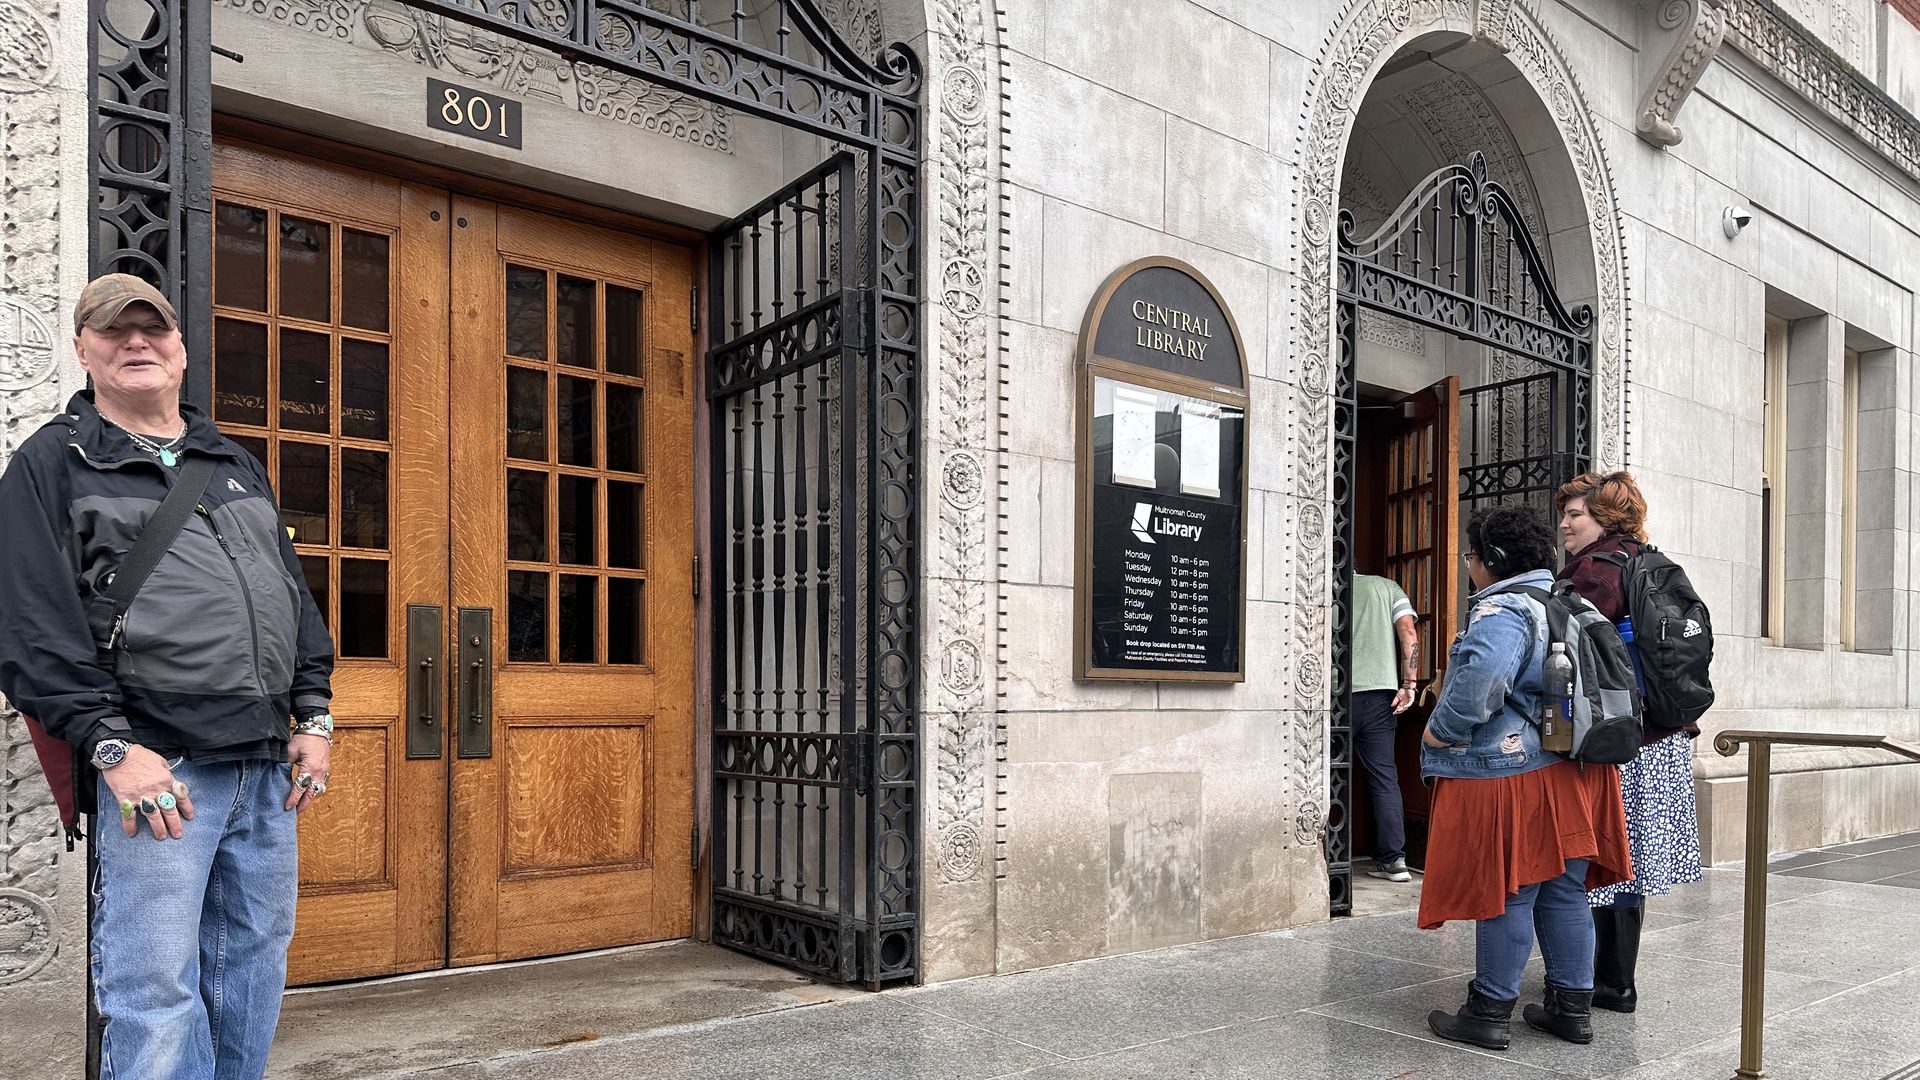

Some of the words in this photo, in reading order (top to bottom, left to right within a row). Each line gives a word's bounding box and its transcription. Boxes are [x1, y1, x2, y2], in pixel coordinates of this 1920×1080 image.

[441, 88, 509, 138] 801
[1132, 299, 1212, 338] CENTRAL
[1136, 325, 1208, 361] LIBRARY
[1154, 505, 1185, 517] Multnomah
[1186, 510, 1206, 521] County
[1154, 516, 1202, 542] Library
[1125, 549, 1151, 561] Monday
[1171, 555, 1178, 563] 10
[1125, 561, 1151, 573] Tuesday
[1171, 567, 1177, 575] 12
[1198, 571, 1209, 579] pm
[1124, 573, 1162, 587] Wednesday
[1170, 579, 1178, 587] 10
[1124, 586, 1154, 598] Thursday
[1170, 590, 1178, 599] 10
[1124, 598, 1145, 609] Friday
[1170, 602, 1178, 611] 10
[1124, 610, 1153, 622] Saturday
[1170, 614, 1177, 623] 10
[1197, 618, 1208, 626] pm
[1124, 622, 1148, 633] Sunday
[1170, 626, 1177, 634] 10
[1140, 640, 1151, 648] drop
[1152, 641, 1170, 649] located
